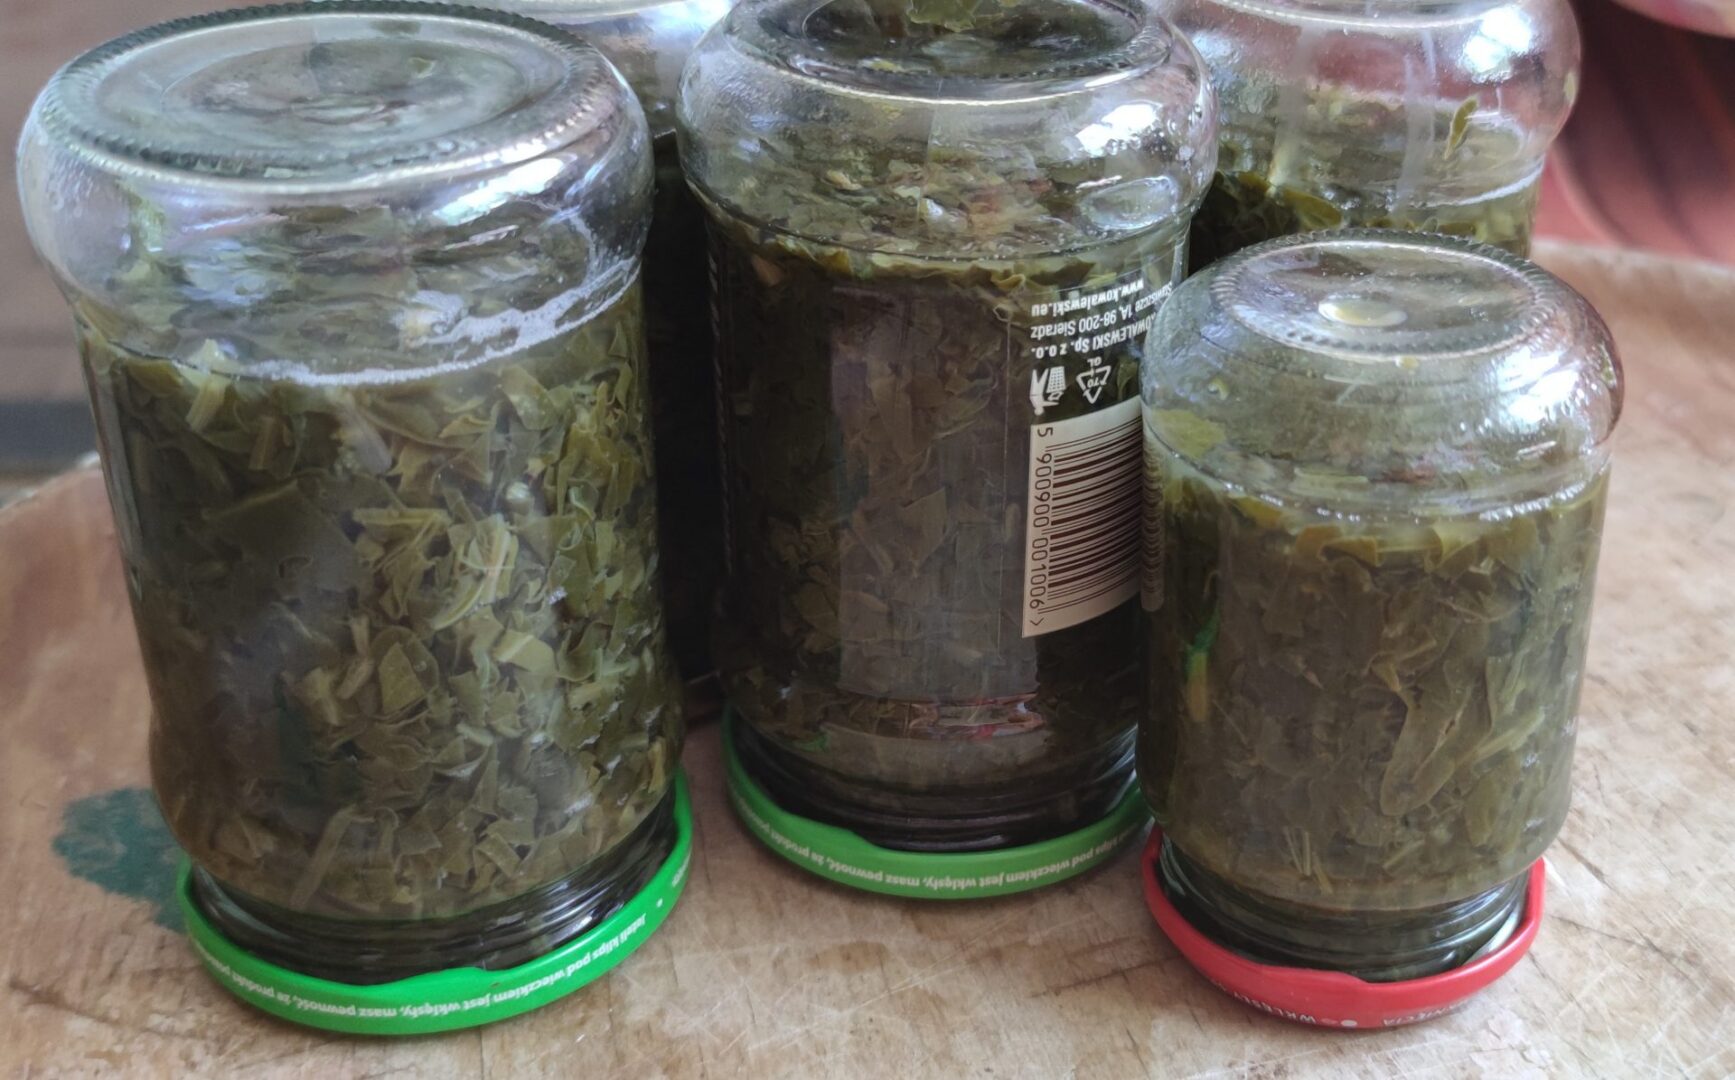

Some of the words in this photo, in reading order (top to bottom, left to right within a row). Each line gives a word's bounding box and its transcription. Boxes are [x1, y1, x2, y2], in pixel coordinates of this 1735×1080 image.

[1031, 278, 1144, 317] www.kowalewski.eu
[1030, 320, 1076, 341] Sieradz
[1079, 310, 1117, 333] 98-200
[1031, 344, 1057, 359] o.o.
[1059, 344, 1068, 356] z
[1070, 336, 1090, 353] Sp.
[1036, 426, 1053, 437] 5
[1033, 453, 1052, 528] 900900
[1029, 536, 1048, 609] 001006
[885, 874, 920, 887] masz
[979, 872, 1004, 888] jest
[1006, 860, 1070, 883] wieczkiem
[567, 953, 592, 977] pod
[493, 969, 566, 1003] wieczkiem
[462, 992, 492, 1012] jest
[358, 1007, 397, 1018] masz
